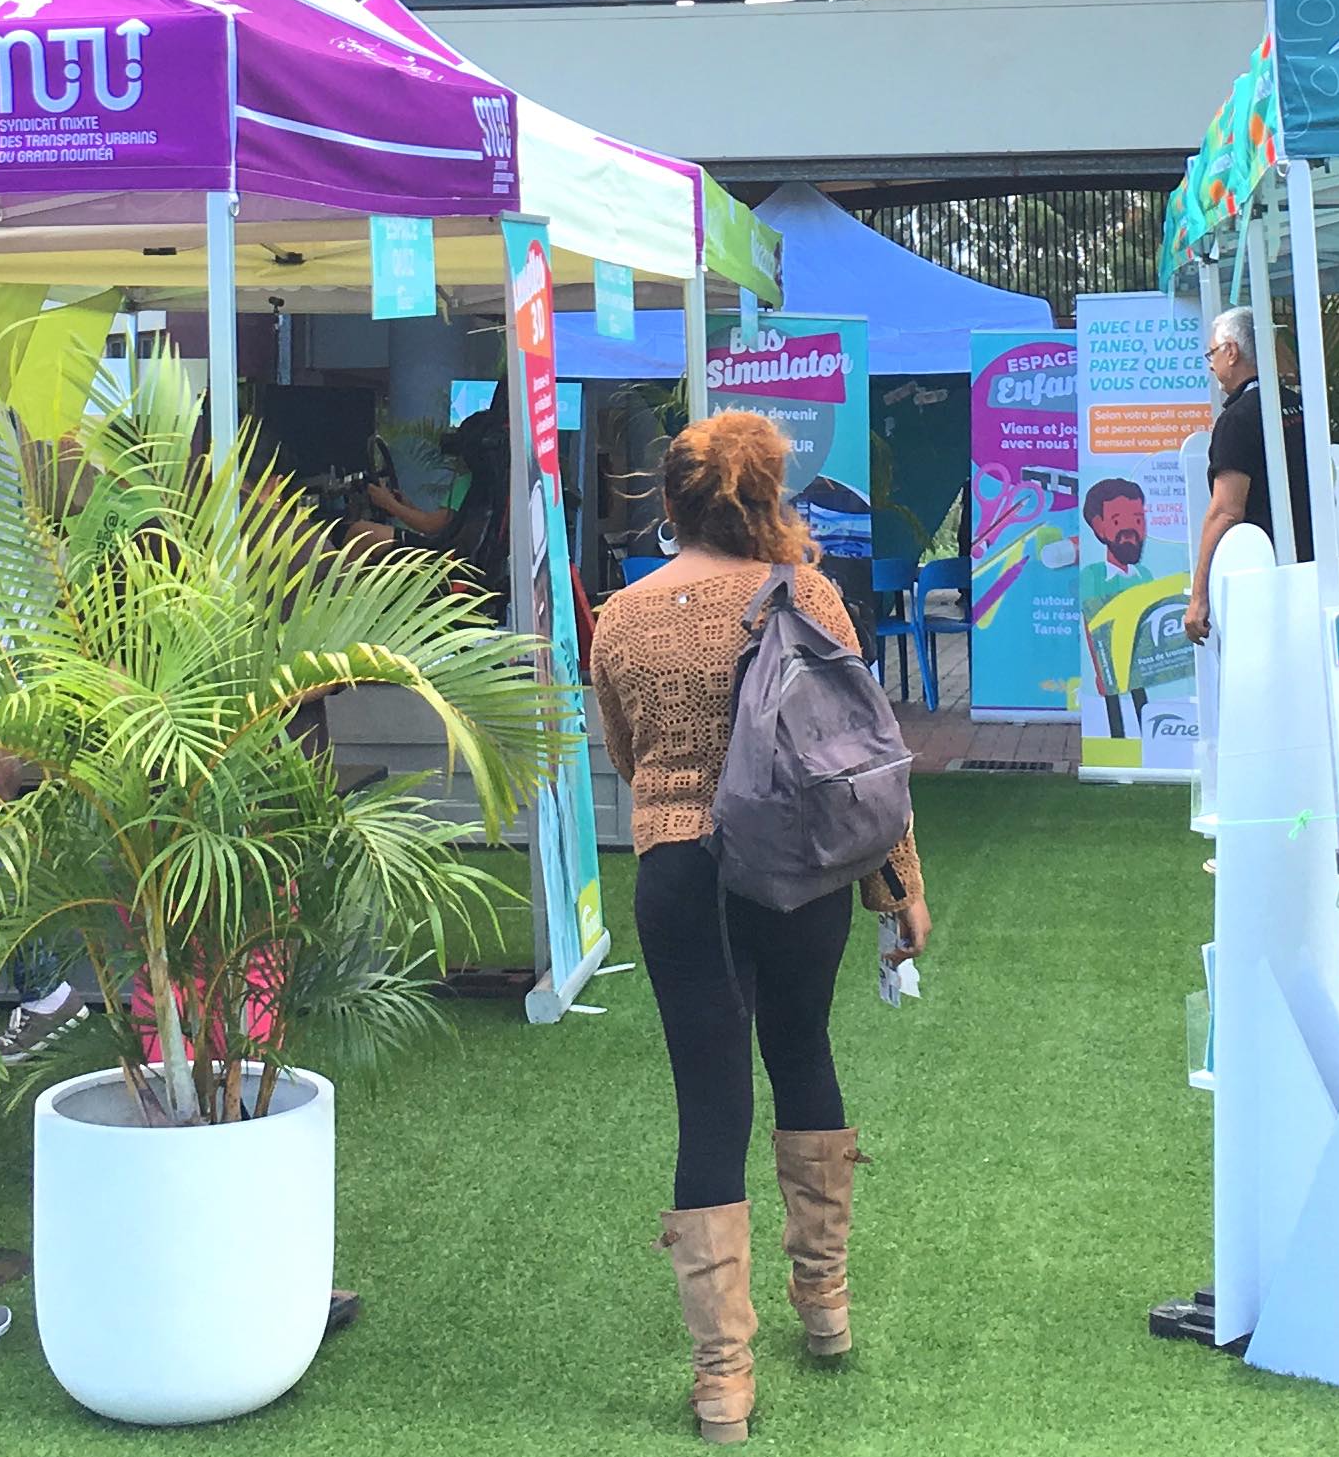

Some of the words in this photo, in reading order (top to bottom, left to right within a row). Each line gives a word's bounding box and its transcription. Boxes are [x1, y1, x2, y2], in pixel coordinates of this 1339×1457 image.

[0, 117, 57, 132] SYNDICAT
[60, 116, 99, 130] MIXTE
[0, 135, 23, 148] DES
[25, 132, 102, 147] TRANSPORTS
[106, 131, 157, 145] URBAINS
[18, 149, 57, 162] GRAND
[61, 145, 113, 161] NOUMÉA
[1088, 320, 1130, 334] AVEC
[1134, 320, 1154, 333] LE
[730, 327, 786, 355] Bus
[1154, 337, 1199, 351] VOUS
[706, 350, 853, 388] Simulator
[1007, 351, 1077, 373] ESPACE
[1089, 358, 1138, 372] PAYEZ
[1144, 357, 1179, 373] QUE
[1183, 356, 1203, 369] CE
[997, 373, 1077, 405] Enfan
[1089, 377, 1134, 391] VOUS
[769, 406, 818, 421] devenir
[1001, 422, 1039, 434] Viens
[1043, 423, 1057, 434] et
[1058, 423, 1078, 437] jou
[1001, 439, 1033, 449] avec
[1036, 439, 1070, 449] nous
[1032, 595, 1075, 606] autour
[1032, 609, 1049, 620] du
[1053, 609, 1080, 621] rése
